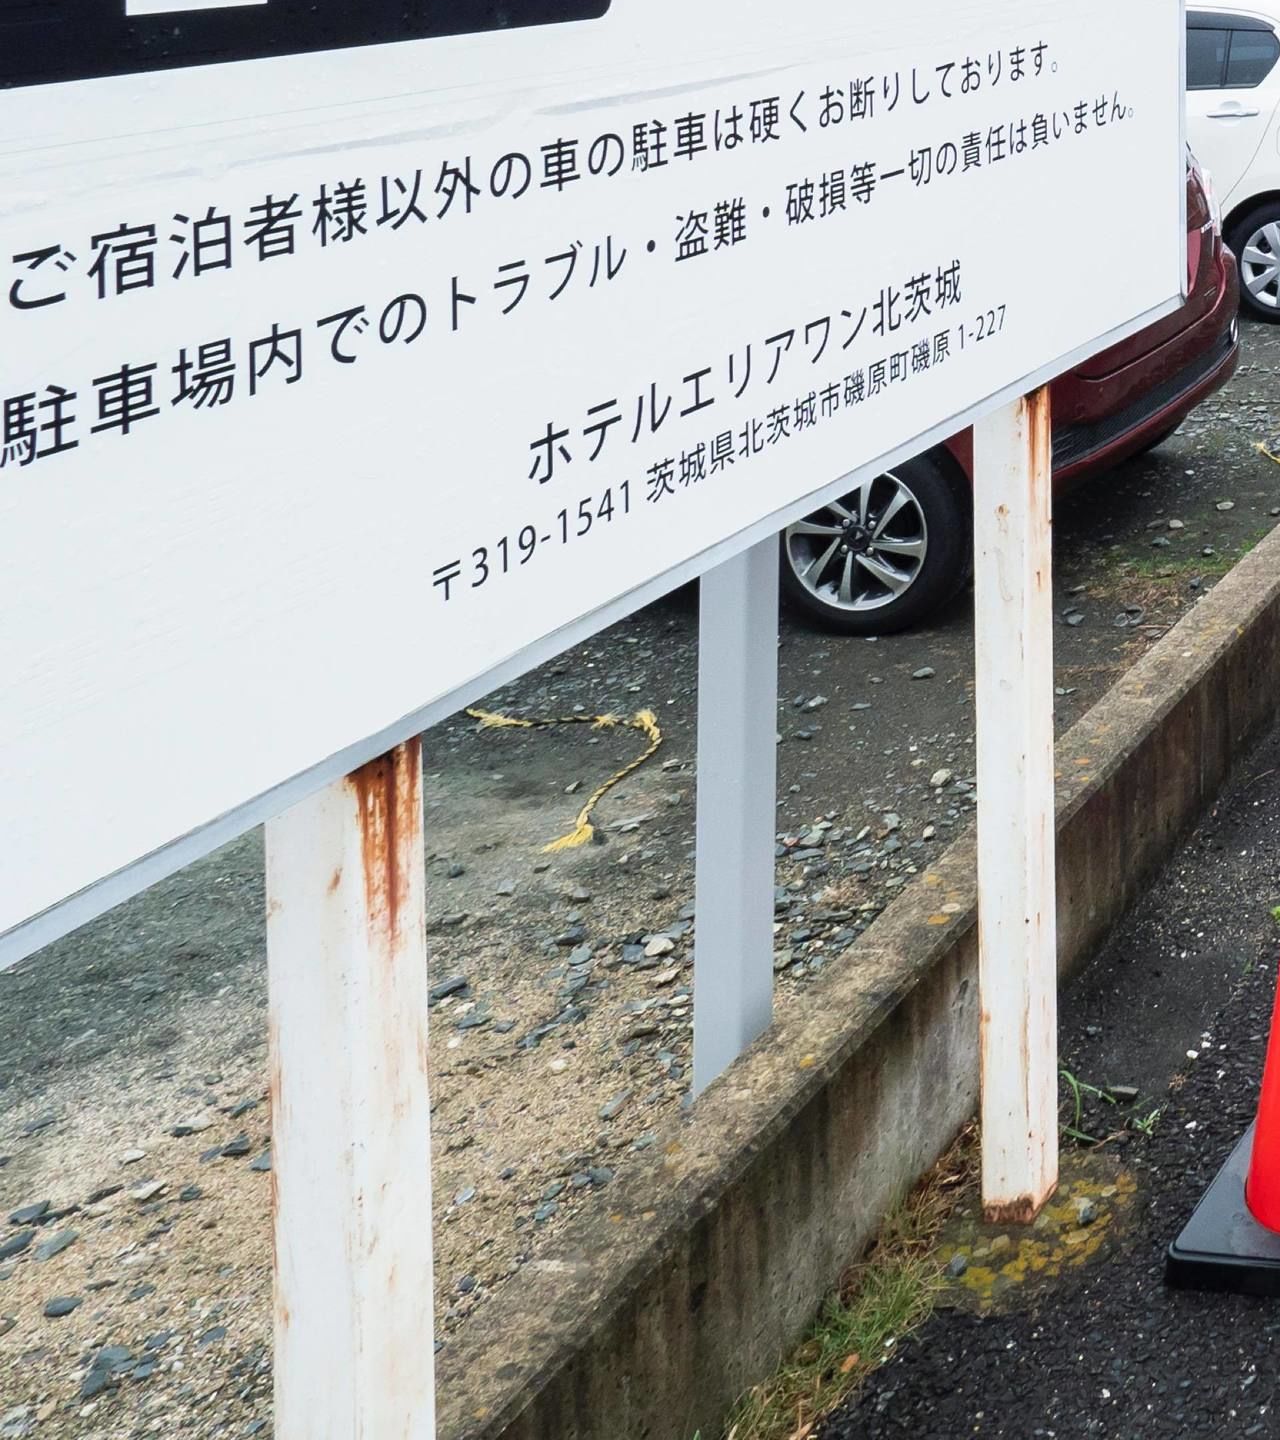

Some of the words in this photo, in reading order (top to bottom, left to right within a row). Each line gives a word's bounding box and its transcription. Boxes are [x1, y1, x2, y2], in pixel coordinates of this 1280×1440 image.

[0, 90, 1135, 469] 駐車場内でのトラブル・盗難・破損等一切の責任は負いません。
[8, 40, 1059, 311] ご宿泊者様以外の車の駐車は硬くお断りしております。
[432, 479, 633, 601] 〒319-1541
[646, 327, 952, 504] 茨城県北茨城市磯原町磯原
[957, 304, 1007, 350] 1-227
[528, 258, 963, 485] ホテルエリアワン北茨城
